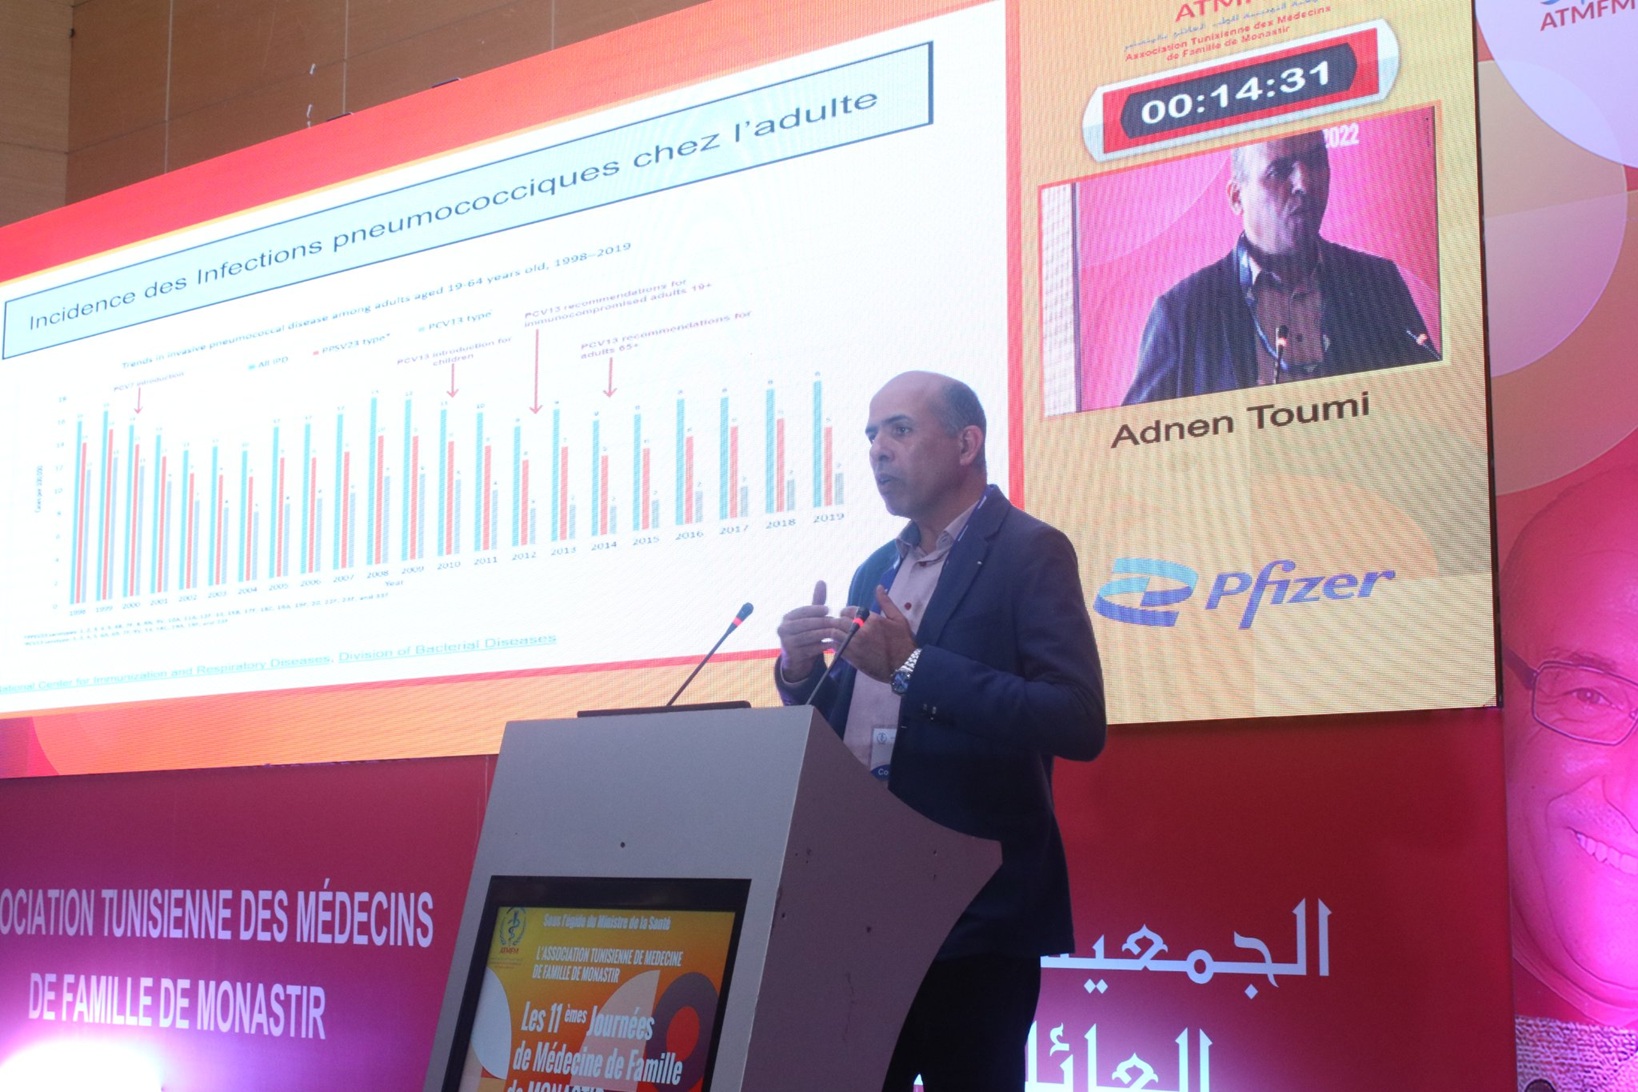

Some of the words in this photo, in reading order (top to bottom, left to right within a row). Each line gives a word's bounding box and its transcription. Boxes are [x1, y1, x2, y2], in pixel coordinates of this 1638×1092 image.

[1125, 40, 1188, 62] Association
[1254, 18, 1274, 30] des
[1166, 52, 1180, 62] de
[1182, 42, 1222, 59] Famille
[1225, 38, 1238, 48] de
[1242, 25, 1290, 43] Monastir
[1140, 61, 1329, 125] 00:14:31
[29, 290, 136, 332] Incidence
[144, 277, 187, 299] des
[197, 240, 323, 285] Infections
[333, 159, 621, 252] pneumococciques
[632, 130, 721, 169] chez
[524, 298, 648, 329] immunocompromised
[650, 288, 687, 303] adults
[563, 283, 668, 310] recommendations
[670, 278, 687, 288] for
[122, 355, 153, 369] Trends
[155, 353, 165, 362] in
[167, 343, 207, 359] invasive
[209, 324, 286, 350] pneumococcal
[287, 315, 329, 331] disease
[332, 305, 372, 321] among
[373, 294, 411, 311] adults
[414, 285, 444, 302] aged
[487, 269, 521, 286] years
[428, 317, 464, 331] PCV13
[580, 336, 620, 351] PCV13
[621, 313, 732, 342] recommendations
[734, 310, 753, 321] for
[432, 339, 496, 358] introduction
[497, 335, 513, 345] for
[433, 353, 475, 367] children
[580, 346, 615, 360] adults
[1110, 414, 1234, 449] Adnen
[1246, 391, 1370, 430] Toumi
[366, 570, 389, 579] 2008
[437, 560, 462, 571] 2010
[473, 555, 498, 567] 2011
[512, 550, 537, 562] 2012
[550, 545, 578, 557] 2013
[590, 540, 618, 552] 2014
[632, 534, 660, 547] 2015
[674, 529, 704, 542] 2016
[719, 523, 749, 536] 2017
[765, 518, 797, 530] 2018
[812, 511, 845, 524] 2019
[384, 579, 404, 588] Year
[1205, 558, 1396, 630] Pfizer
[38, 679, 73, 690] Center
[75, 676, 90, 686] for
[93, 668, 168, 685] Immunization
[170, 667, 193, 677] and
[196, 660, 266, 677] Respiratory
[338, 650, 393, 662] Division
[397, 645, 412, 656] of
[415, 640, 480, 655] Bacterial
[484, 634, 557, 649] Diseases
[101, 888, 233, 940] TUNISIENNE
[239, 889, 289, 943] DES
[295, 878, 434, 948] MÉDECINS
[532, 964, 543, 979] DE
[543, 965, 571, 981] FAMILLE
[571, 966, 582, 981] DE
[581, 967, 621, 983] MONASTIR
[590, 947, 634, 964] TUNISIENNE
[633, 949, 645, 965] DE
[644, 950, 684, 967] MEDECINE
[28, 972, 56, 1021] DE
[61, 973, 154, 1027] FAMILLE
[159, 977, 190, 1030] DE
[197, 979, 327, 1040] MONASTIR
[520, 1001, 547, 1033] Les
[547, 1003, 563, 1034] 11
[564, 1003, 588, 1024] èmes
[586, 1005, 656, 1041] Journées
[512, 1040, 532, 1071] de
[532, 1041, 604, 1078] Médecine
[604, 1047, 625, 1080] de
[626, 1049, 684, 1086] Famille
